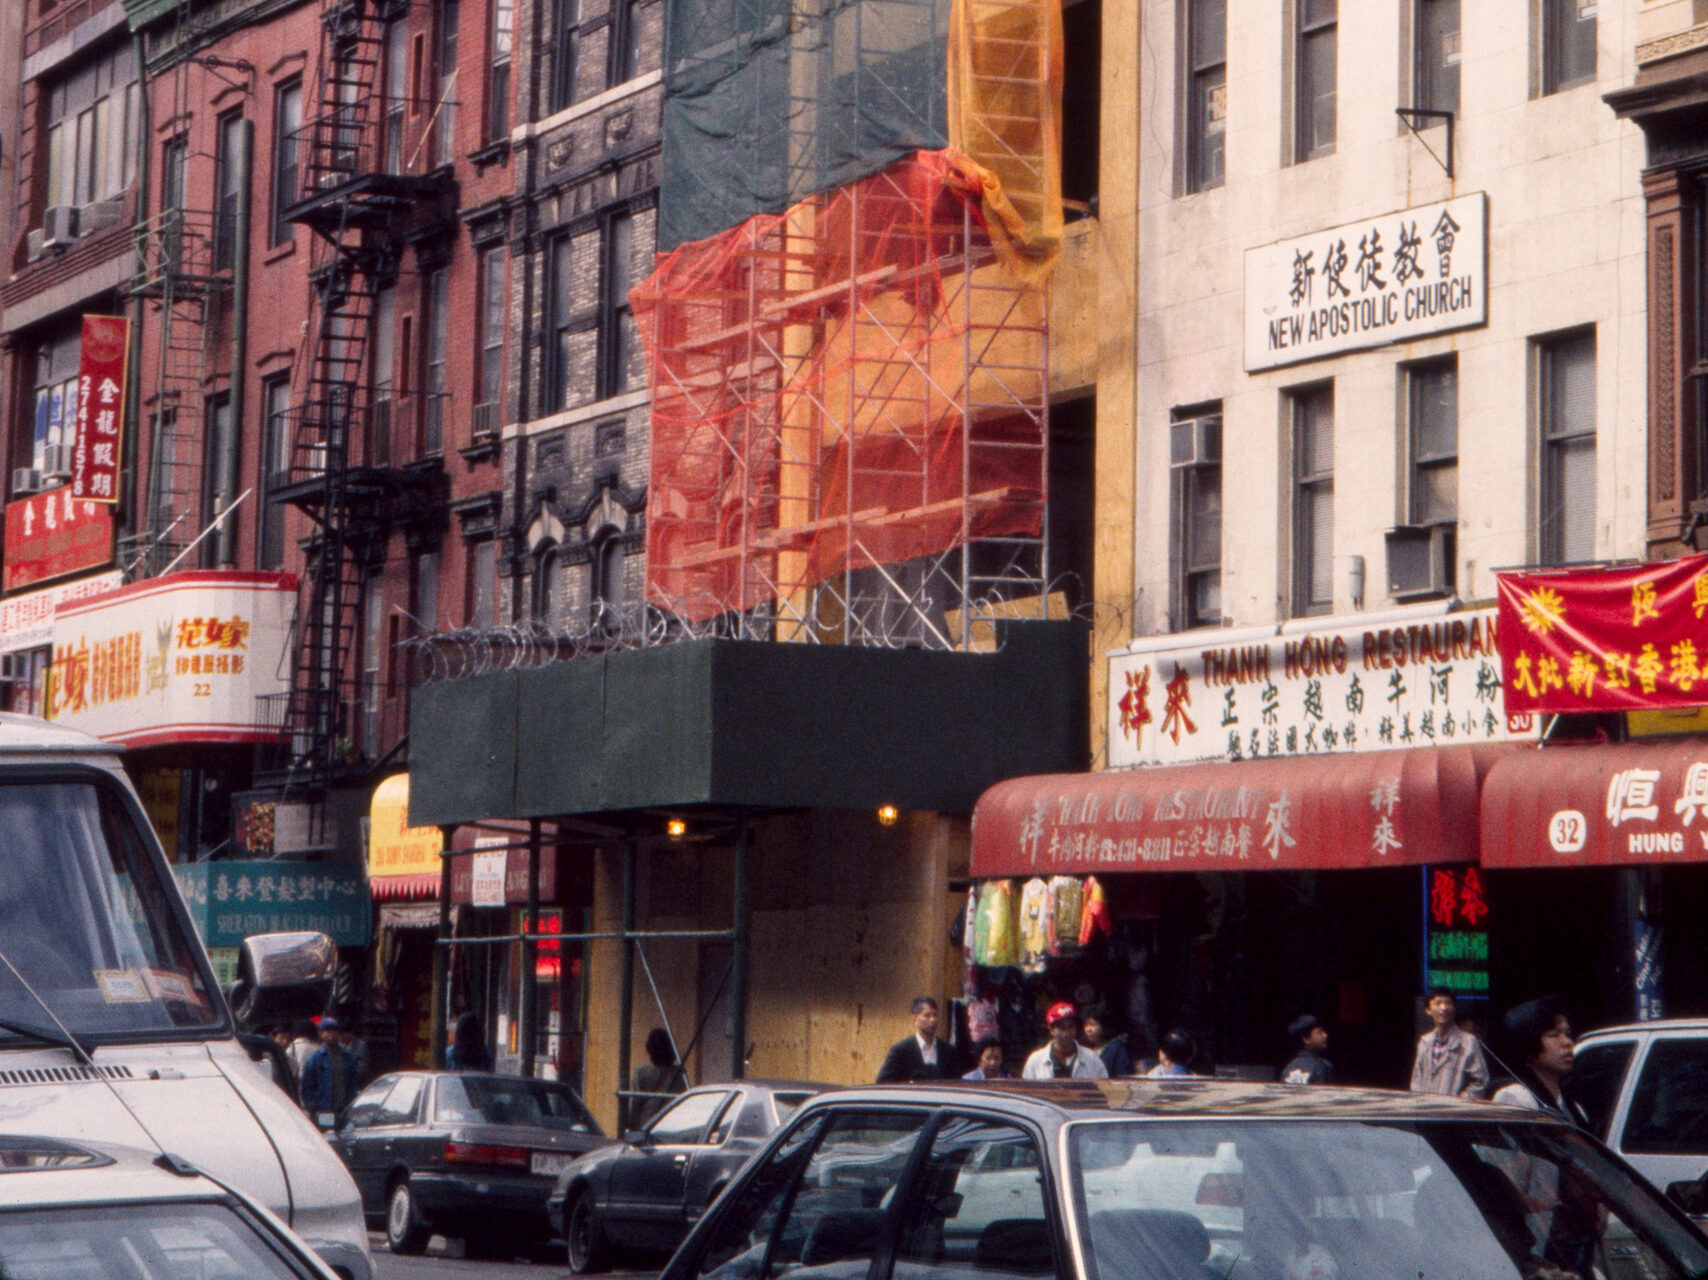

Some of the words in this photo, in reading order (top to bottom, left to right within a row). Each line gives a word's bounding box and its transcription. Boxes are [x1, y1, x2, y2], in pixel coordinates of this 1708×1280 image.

[1288, 208, 1462, 308] 新使徒教會
[1268, 313, 1305, 351] NEW
[1308, 291, 1398, 342] APOSTOLIC
[1404, 275, 1472, 321] CHURCH
[73, 375, 91, 496] 274-1578
[90, 378, 120, 497] 金龍假期
[1201, 643, 1271, 688] THANH
[1362, 614, 1500, 671] RESTAURAN
[1512, 638, 1708, 698] 大批新到香港
[193, 683, 211, 697] 22
[1117, 660, 1198, 751] 祥來
[1221, 659, 1502, 727] 正宗越南牛河粉
[1369, 778, 1403, 855] 祥來
[1556, 818, 1579, 844] 32
[1628, 832, 1684, 854] HUNG
